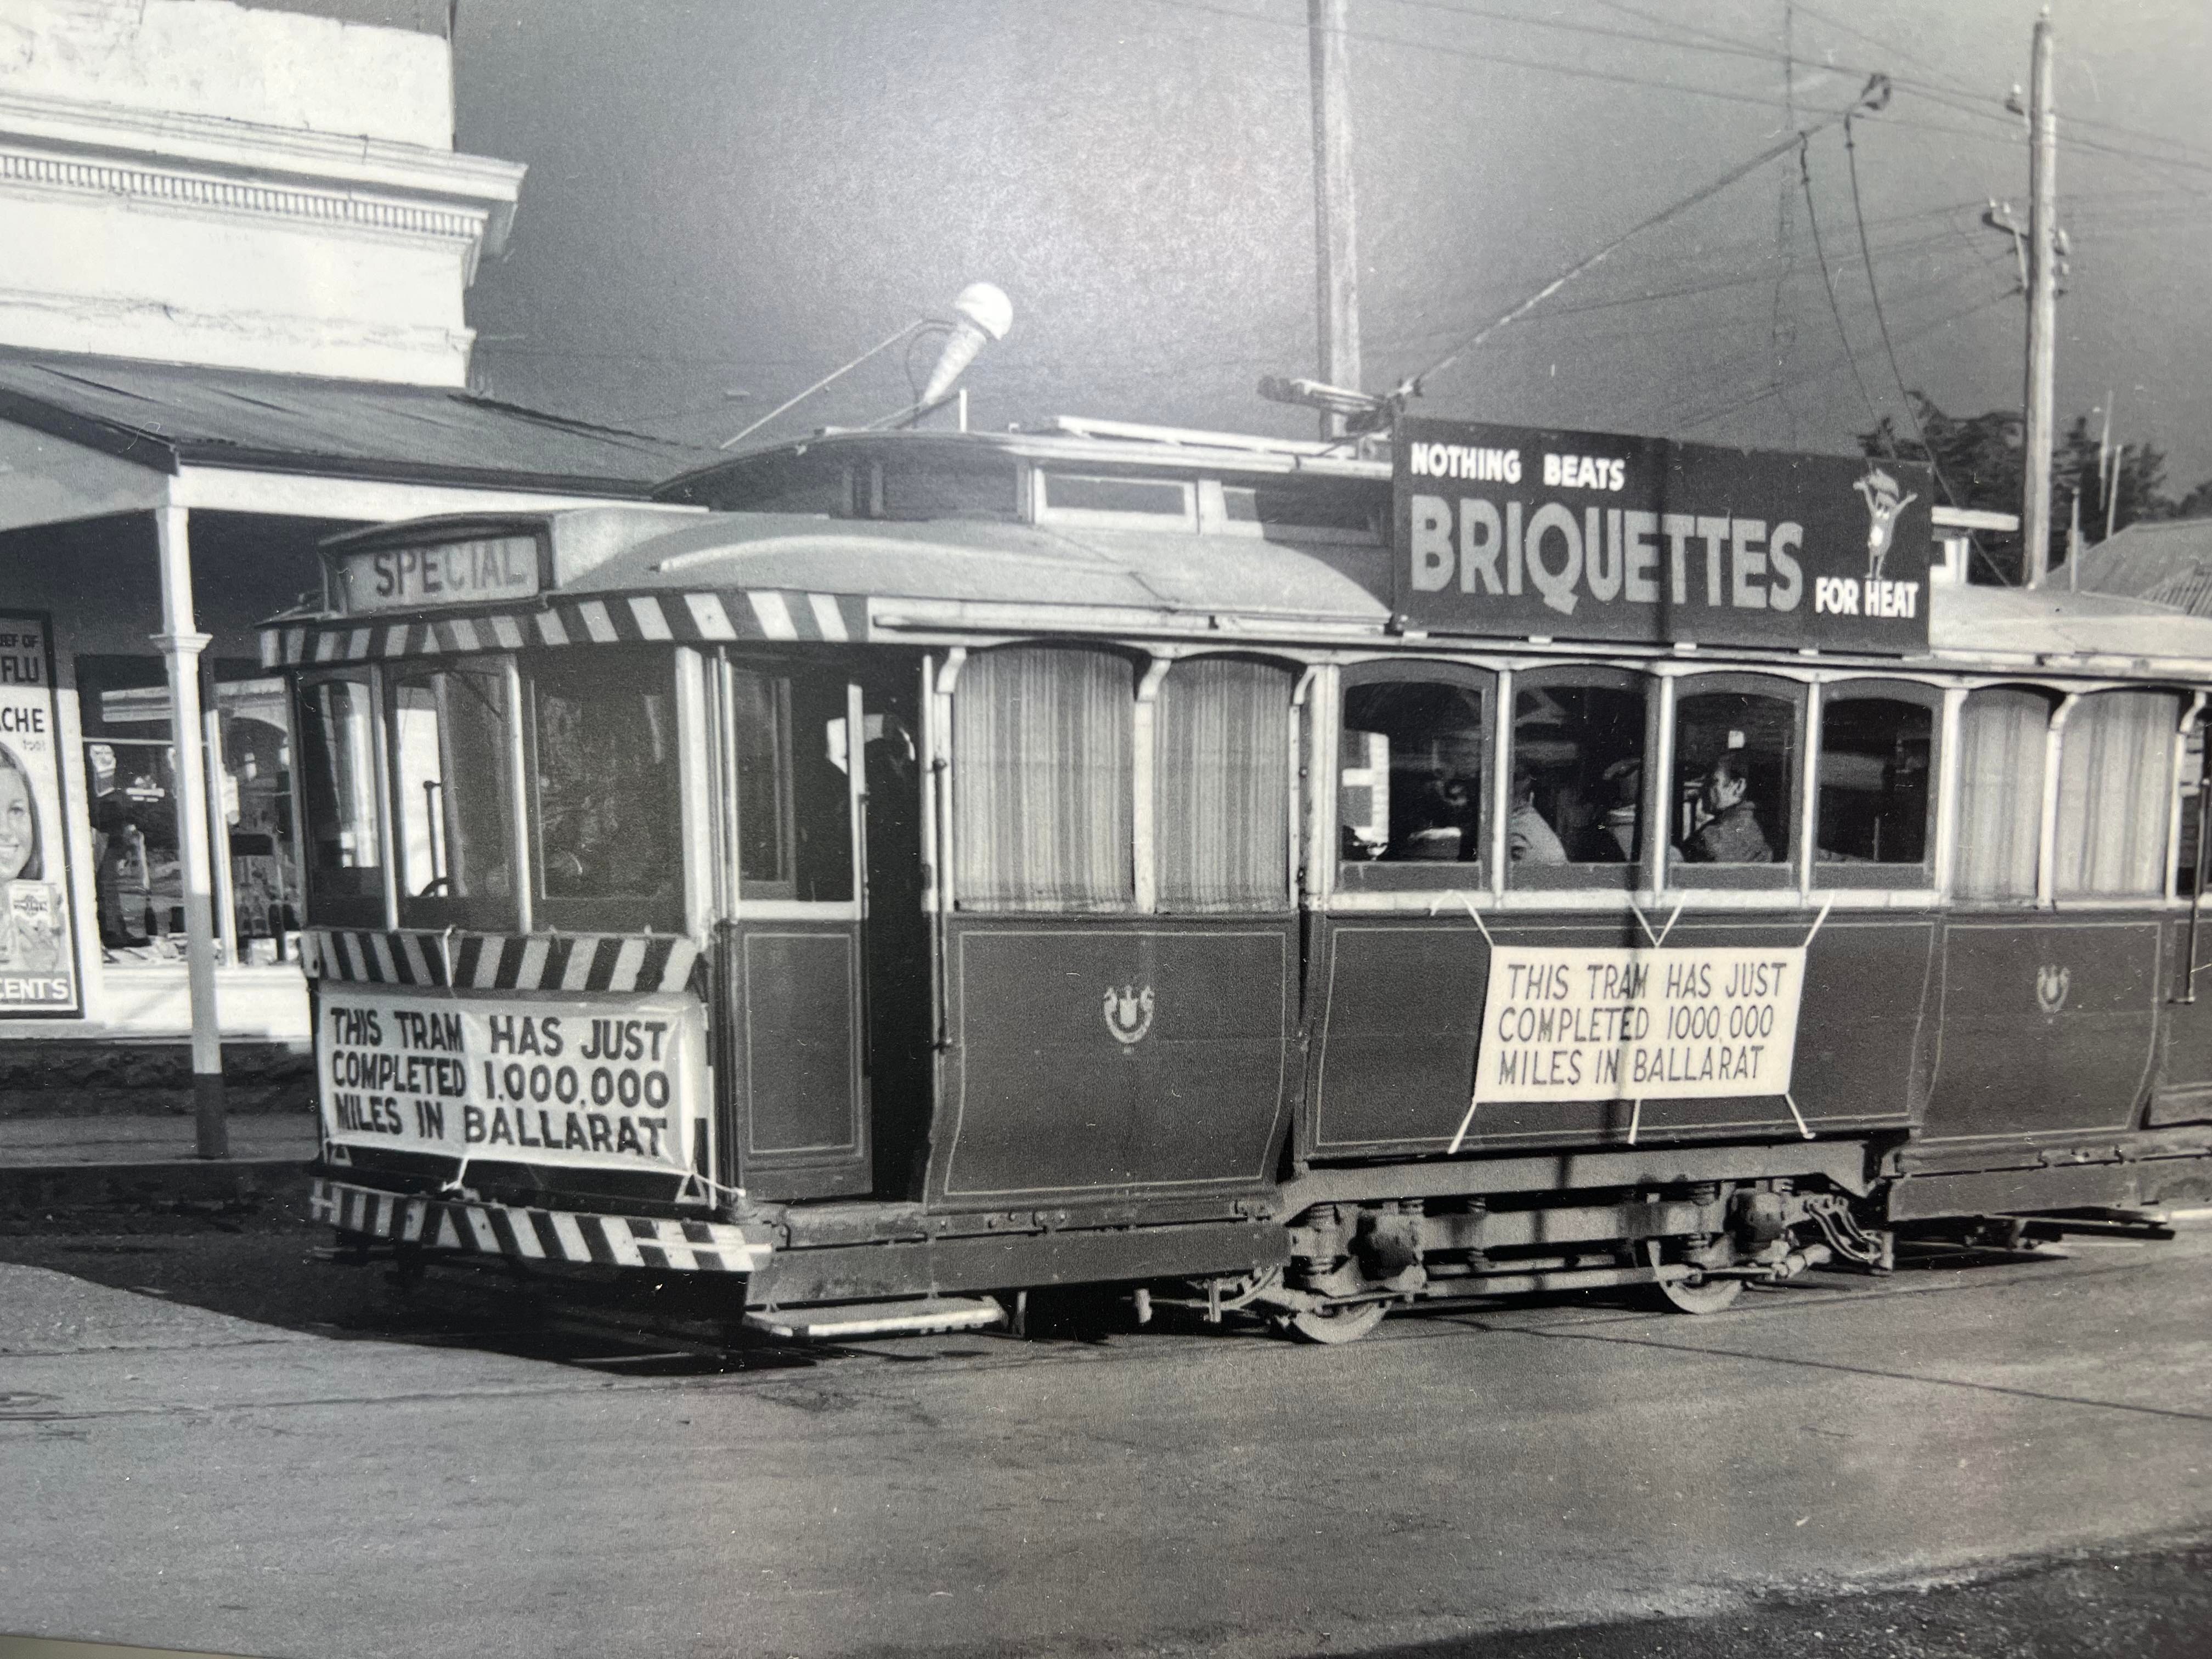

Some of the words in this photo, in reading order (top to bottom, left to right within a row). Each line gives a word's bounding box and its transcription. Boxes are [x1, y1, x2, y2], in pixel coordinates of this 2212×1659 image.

[1410, 443, 1521, 483] NOTHING
[1543, 453, 1626, 492] BEATS
[375, 540, 528, 597] SPECIAL
[1410, 494, 1804, 616] BRIQUETTES
[1815, 578, 1860, 616] FOR
[1865, 580, 1919, 618] HEAT
[22, 634, 38, 648] OF
[3, 657, 38, 682] FLU
[0, 707, 45, 733] CHE
[1508, 964, 1570, 1000] THIS
[1587, 964, 1650, 998] TRAM
[1666, 963, 1712, 997] HAS
[1725, 962, 1787, 997] JUST
[330, 1007, 382, 1046] THIS
[394, 1011, 465, 1052] TRAM
[489, 1015, 564, 1057] HAS
[581, 1019, 668, 1060] JUST
[1498, 1005, 1650, 1042] COMPLETED
[332, 1052, 467, 1097] COMPLETED
[1498, 1050, 1582, 1085] MILES
[1595, 1048, 1621, 1084] IN
[1633, 1045, 1764, 1082] BALLARAT
[334, 1093, 402, 1135] MILES
[415, 1101, 444, 1139] IN
[465, 1104, 668, 1157] BALLARAT
